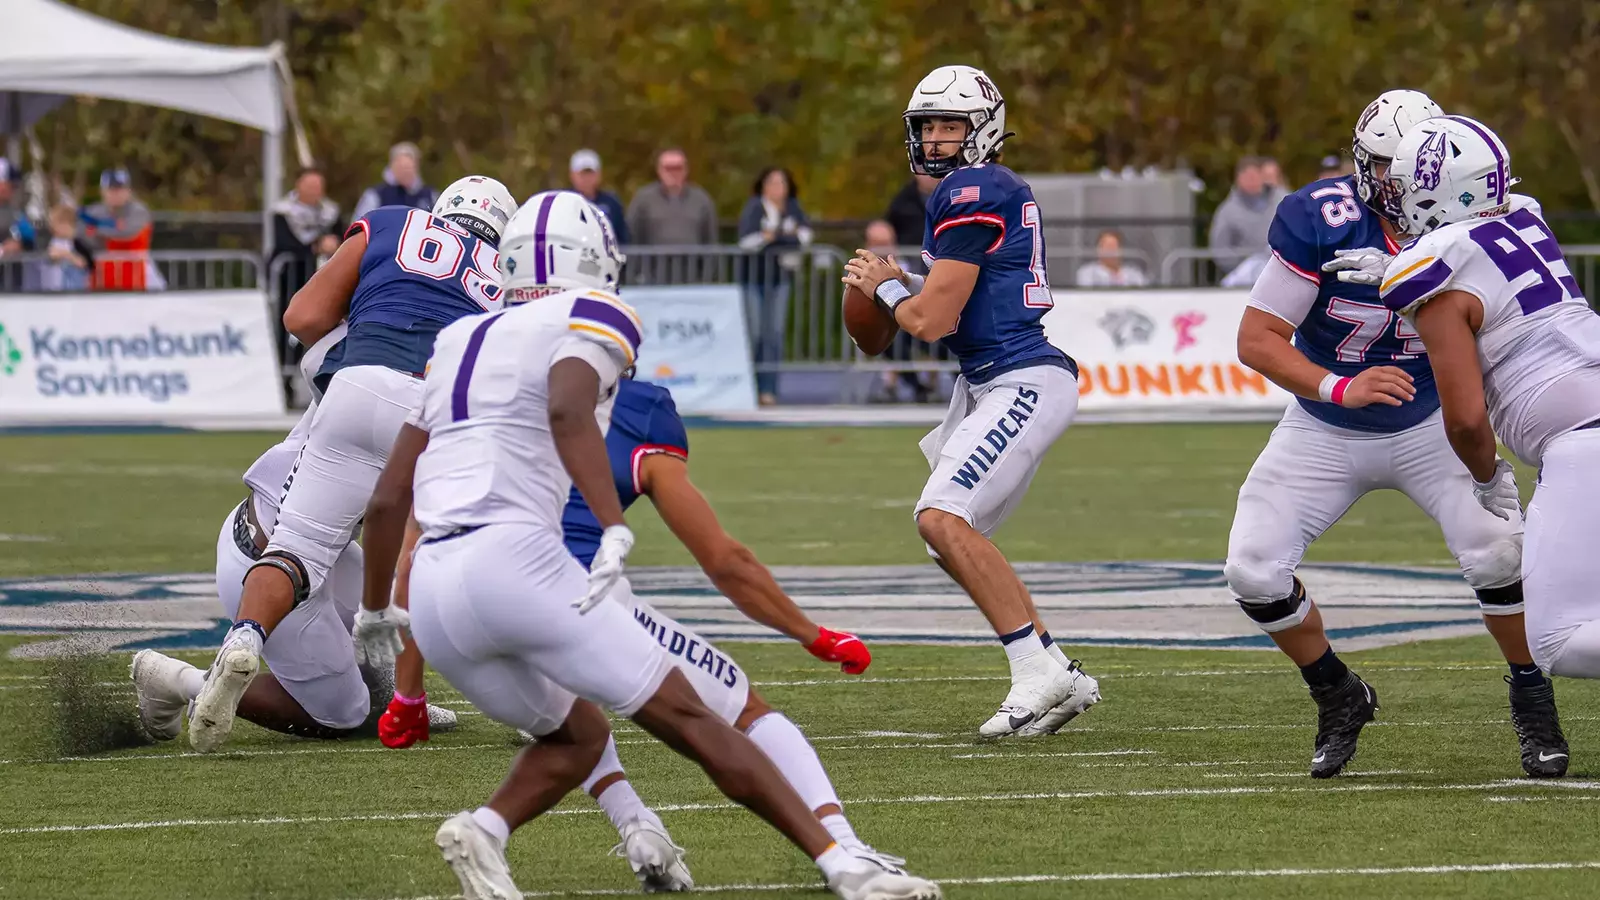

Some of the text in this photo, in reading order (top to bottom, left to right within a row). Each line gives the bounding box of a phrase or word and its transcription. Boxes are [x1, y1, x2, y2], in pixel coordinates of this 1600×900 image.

[455, 216, 474, 226] FREE
[474, 221, 485, 231] OR
[484, 227, 496, 239] DIE
[1310, 181, 1362, 228] 73
[1469, 208, 1585, 316] 93
[30, 325, 249, 360] Kennebunk
[452, 312, 505, 422] 1
[36, 366, 189, 401] Savings
[951, 386, 1038, 490] WILDCATS
[634, 607, 739, 689] WILDCATS
